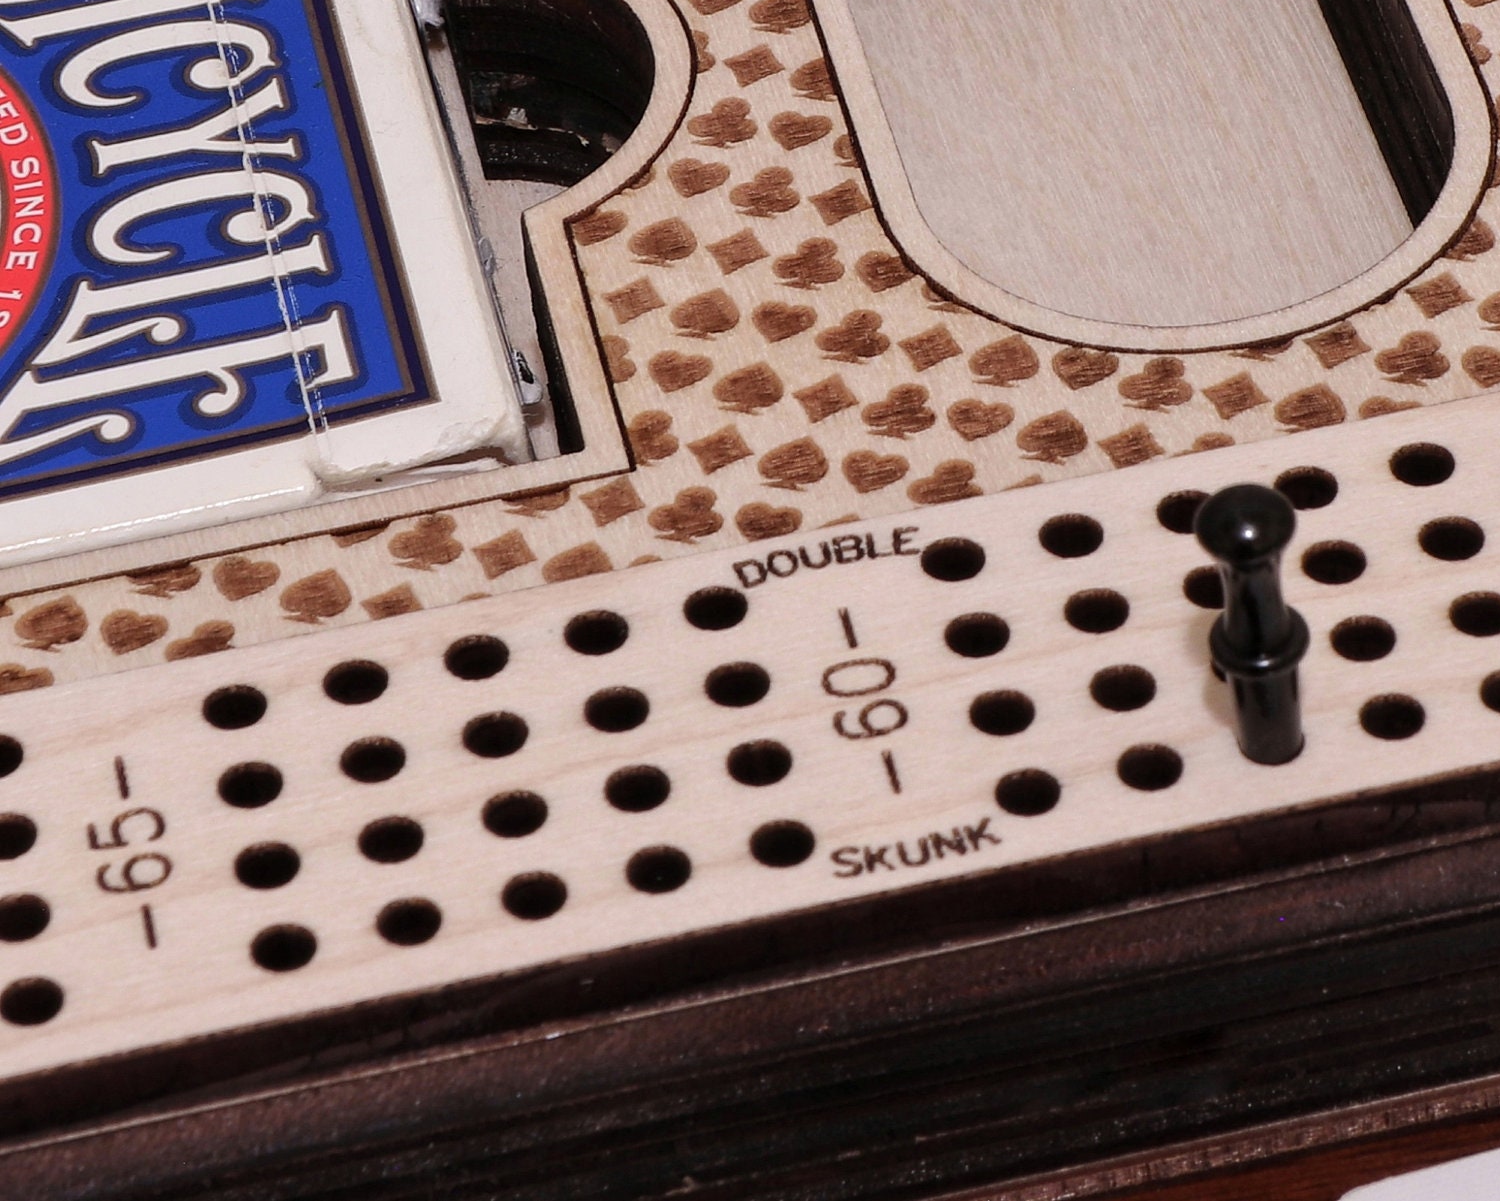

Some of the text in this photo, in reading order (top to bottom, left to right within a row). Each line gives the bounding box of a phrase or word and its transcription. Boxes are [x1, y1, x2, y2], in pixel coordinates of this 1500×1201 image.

[5, 157, 45, 270] SINCE
[733, 524, 921, 589] DOUBLE
[829, 816, 1003, 879] SKUNK
